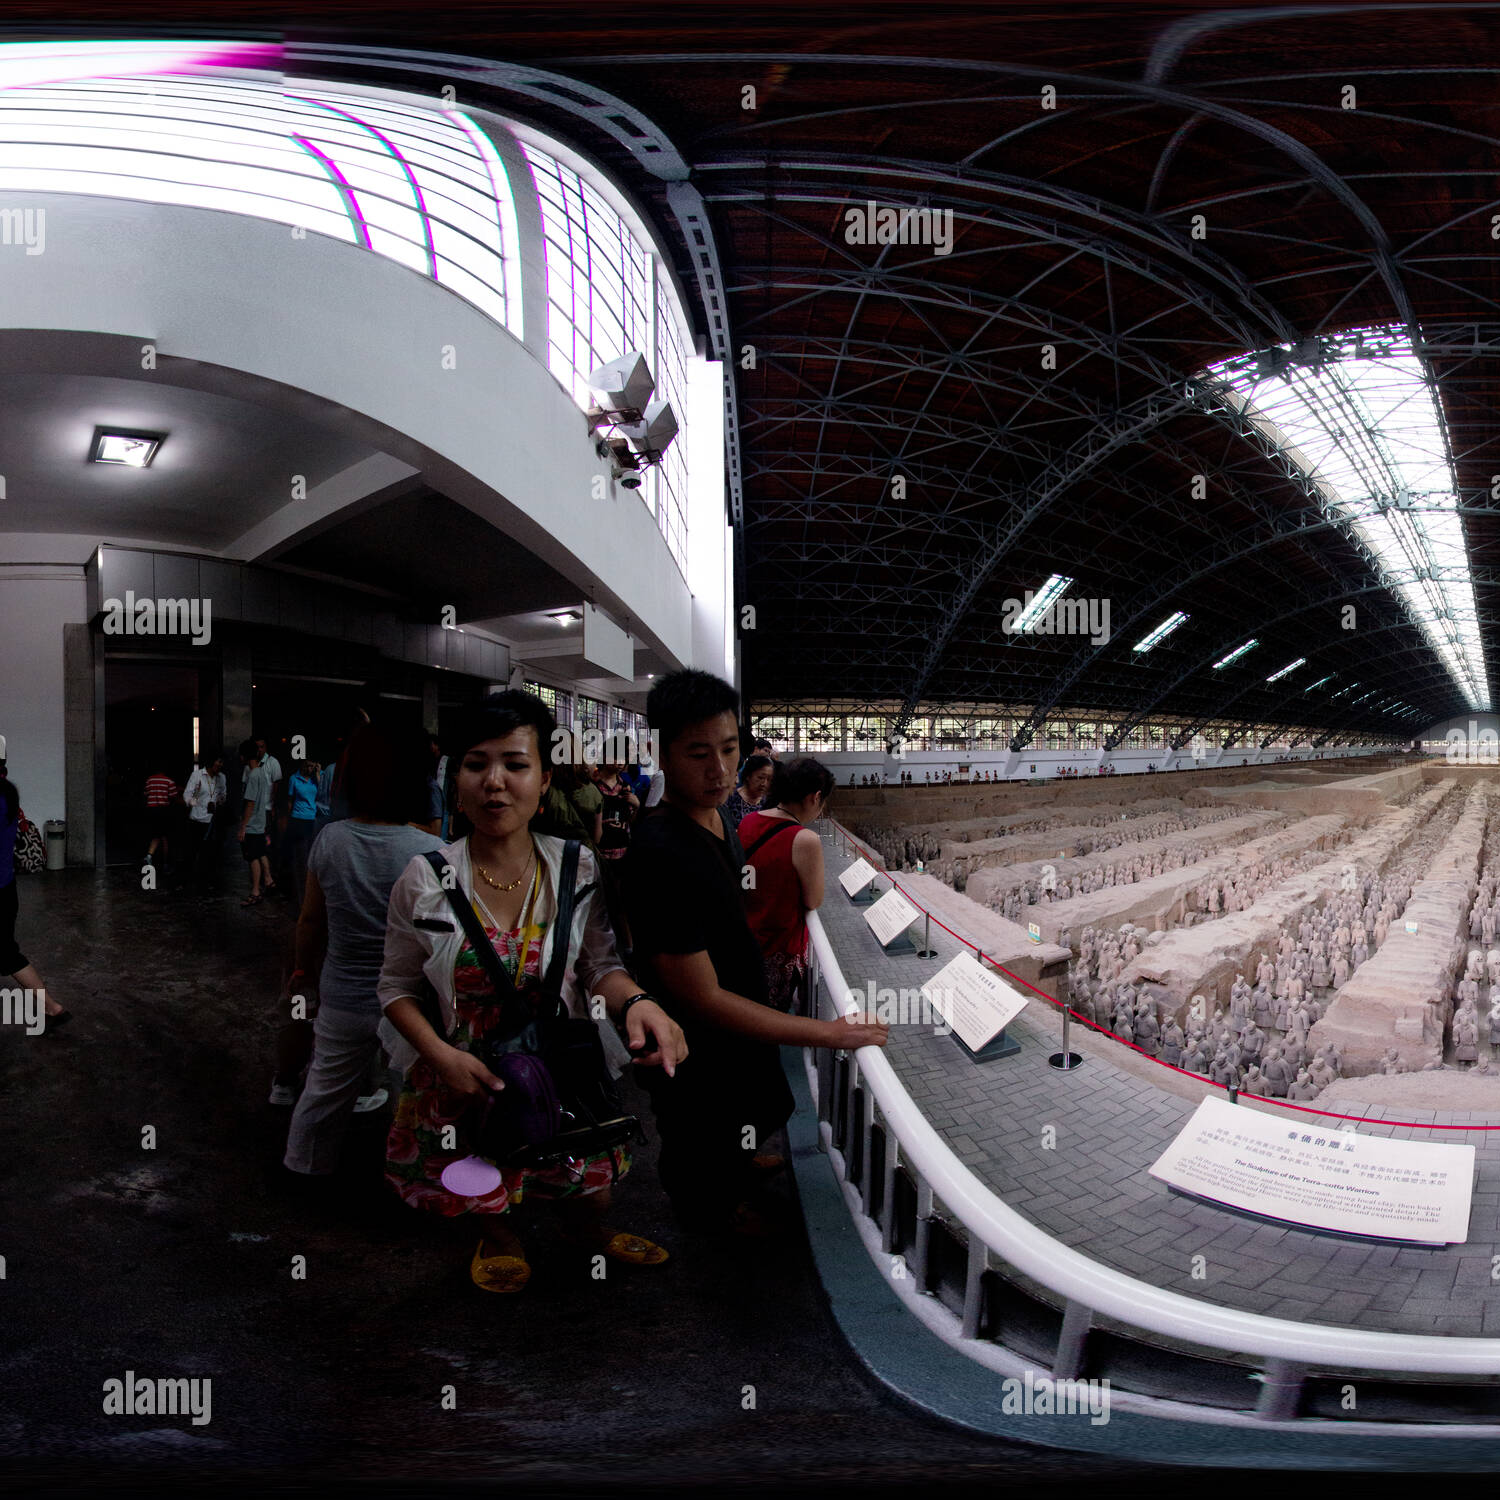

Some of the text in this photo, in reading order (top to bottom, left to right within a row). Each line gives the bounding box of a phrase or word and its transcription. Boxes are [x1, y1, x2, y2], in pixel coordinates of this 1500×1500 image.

[1246, 1163, 1279, 1176] Sculpture
[1288, 1173, 1300, 1181] the
[1345, 1185, 1380, 1196] Warriors
